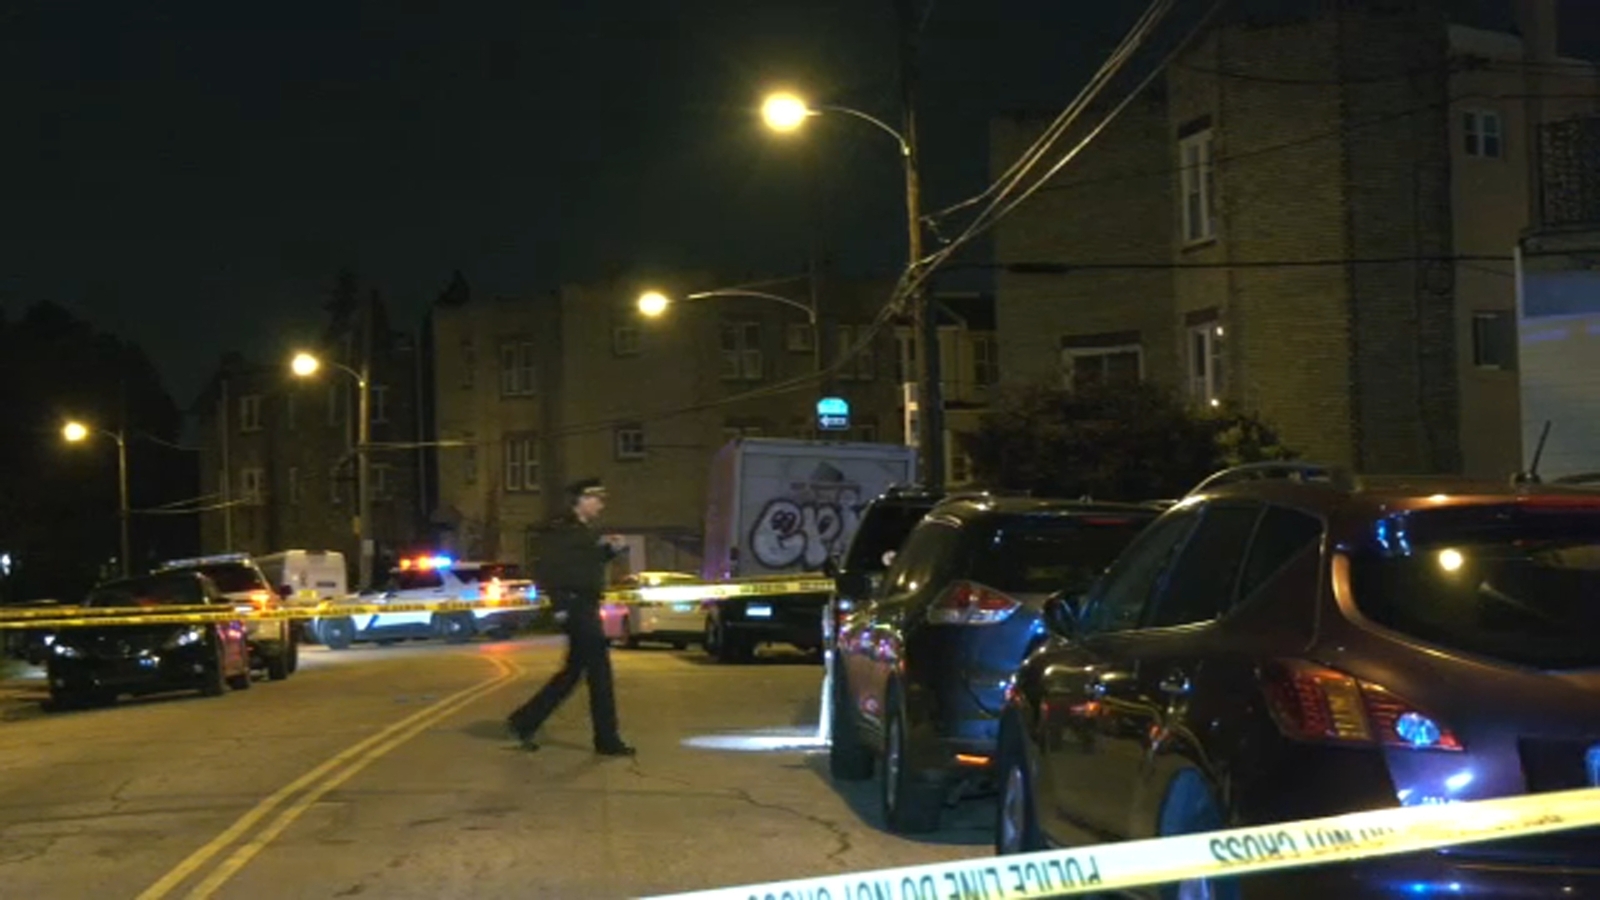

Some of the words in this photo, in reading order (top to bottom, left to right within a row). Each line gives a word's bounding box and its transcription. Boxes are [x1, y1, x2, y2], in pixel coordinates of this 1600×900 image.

[1209, 830, 1300, 866] CROSS
[901, 874, 938, 900] DO
[944, 867, 1005, 900] LINE
[1008, 855, 1102, 895] POLICE
